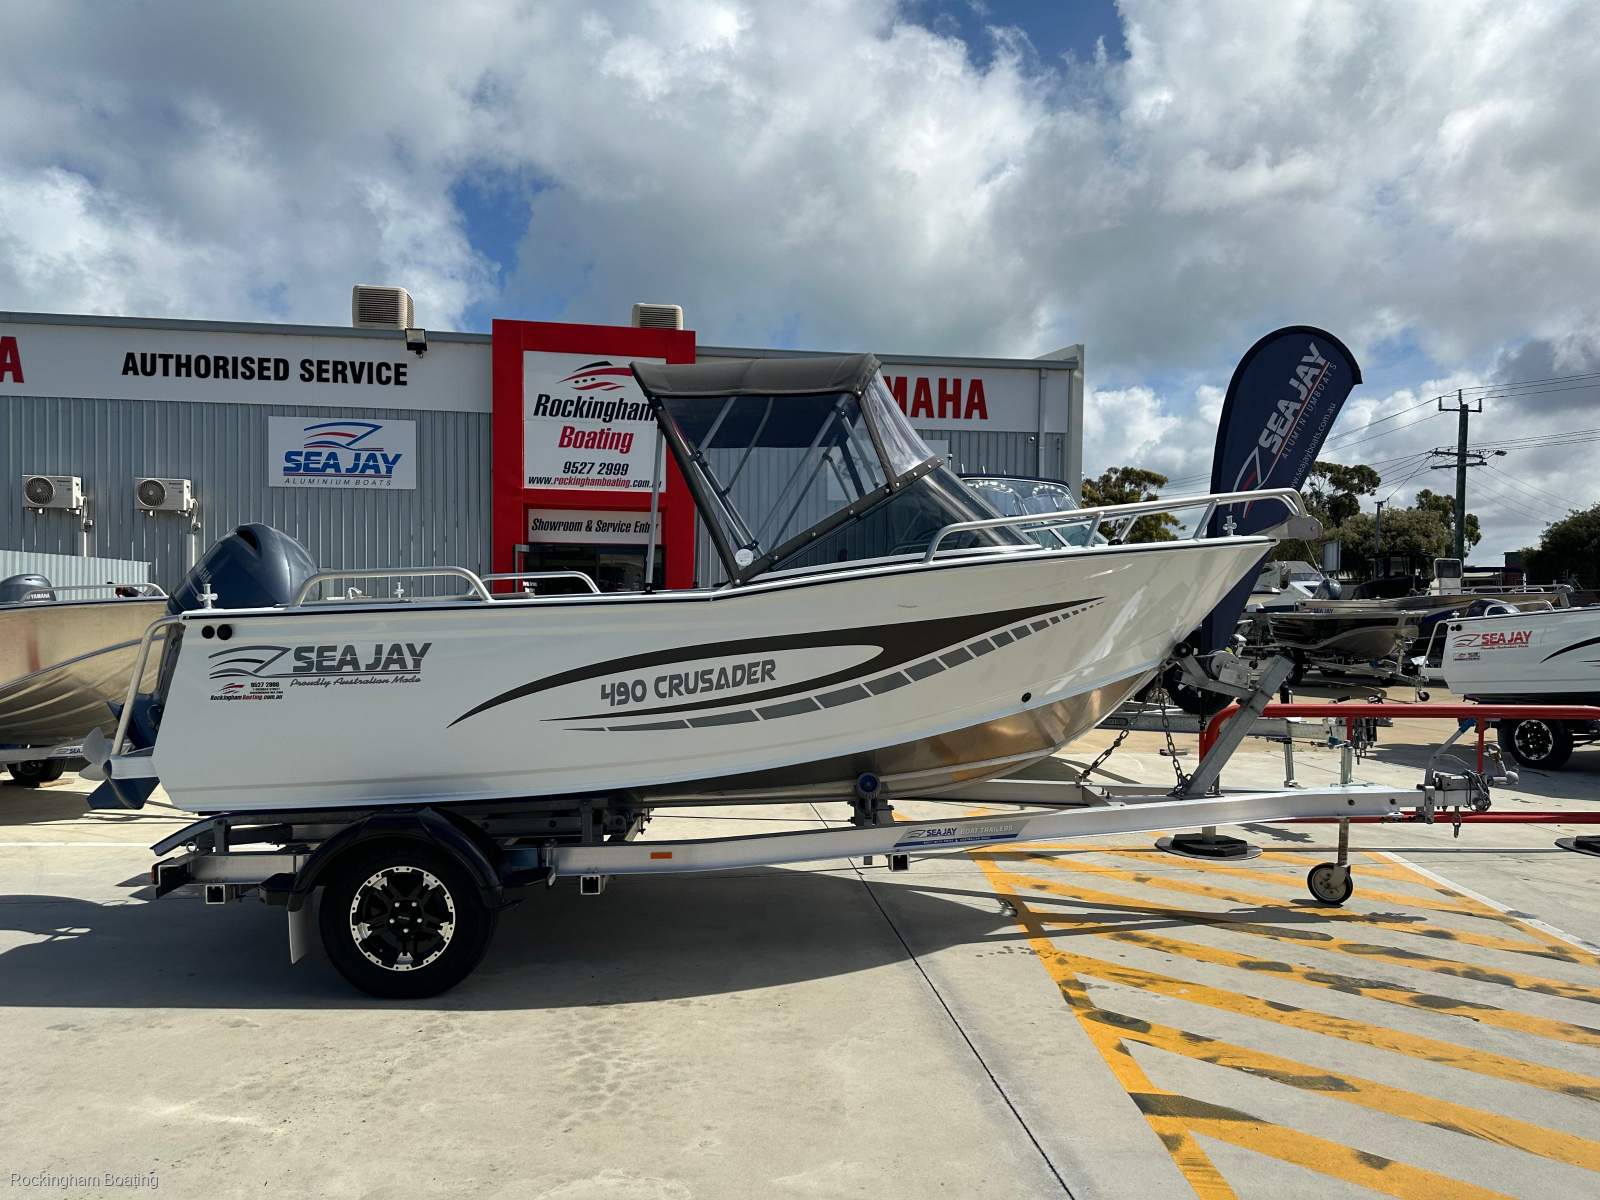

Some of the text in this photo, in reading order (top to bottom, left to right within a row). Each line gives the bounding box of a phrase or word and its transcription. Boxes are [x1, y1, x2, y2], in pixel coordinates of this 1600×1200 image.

[121, 352, 408, 386] AUTHORISED SERVICE
[533, 393, 657, 424] Rockingham
[1258, 341, 1328, 455] SEA JAY
[558, 425, 635, 455] Boating
[283, 450, 403, 475] SEA JAY
[562, 461, 630, 476] 9527 2999
[284, 478, 351, 486] ALUMINIUM
[531, 518, 584, 532] Showroom
[584, 519, 594, 532] &
[594, 520, 632, 533] Service
[1481, 630, 1533, 646] SEA JAY
[292, 642, 432, 672] SEA JAY
[289, 677, 331, 688] Proudly
[332, 677, 389, 687] Australian
[391, 676, 421, 684] Made
[600, 659, 777, 706] 490 CRUSADER
[926, 829, 941, 837] SEA
[942, 827, 957, 836] JAY
